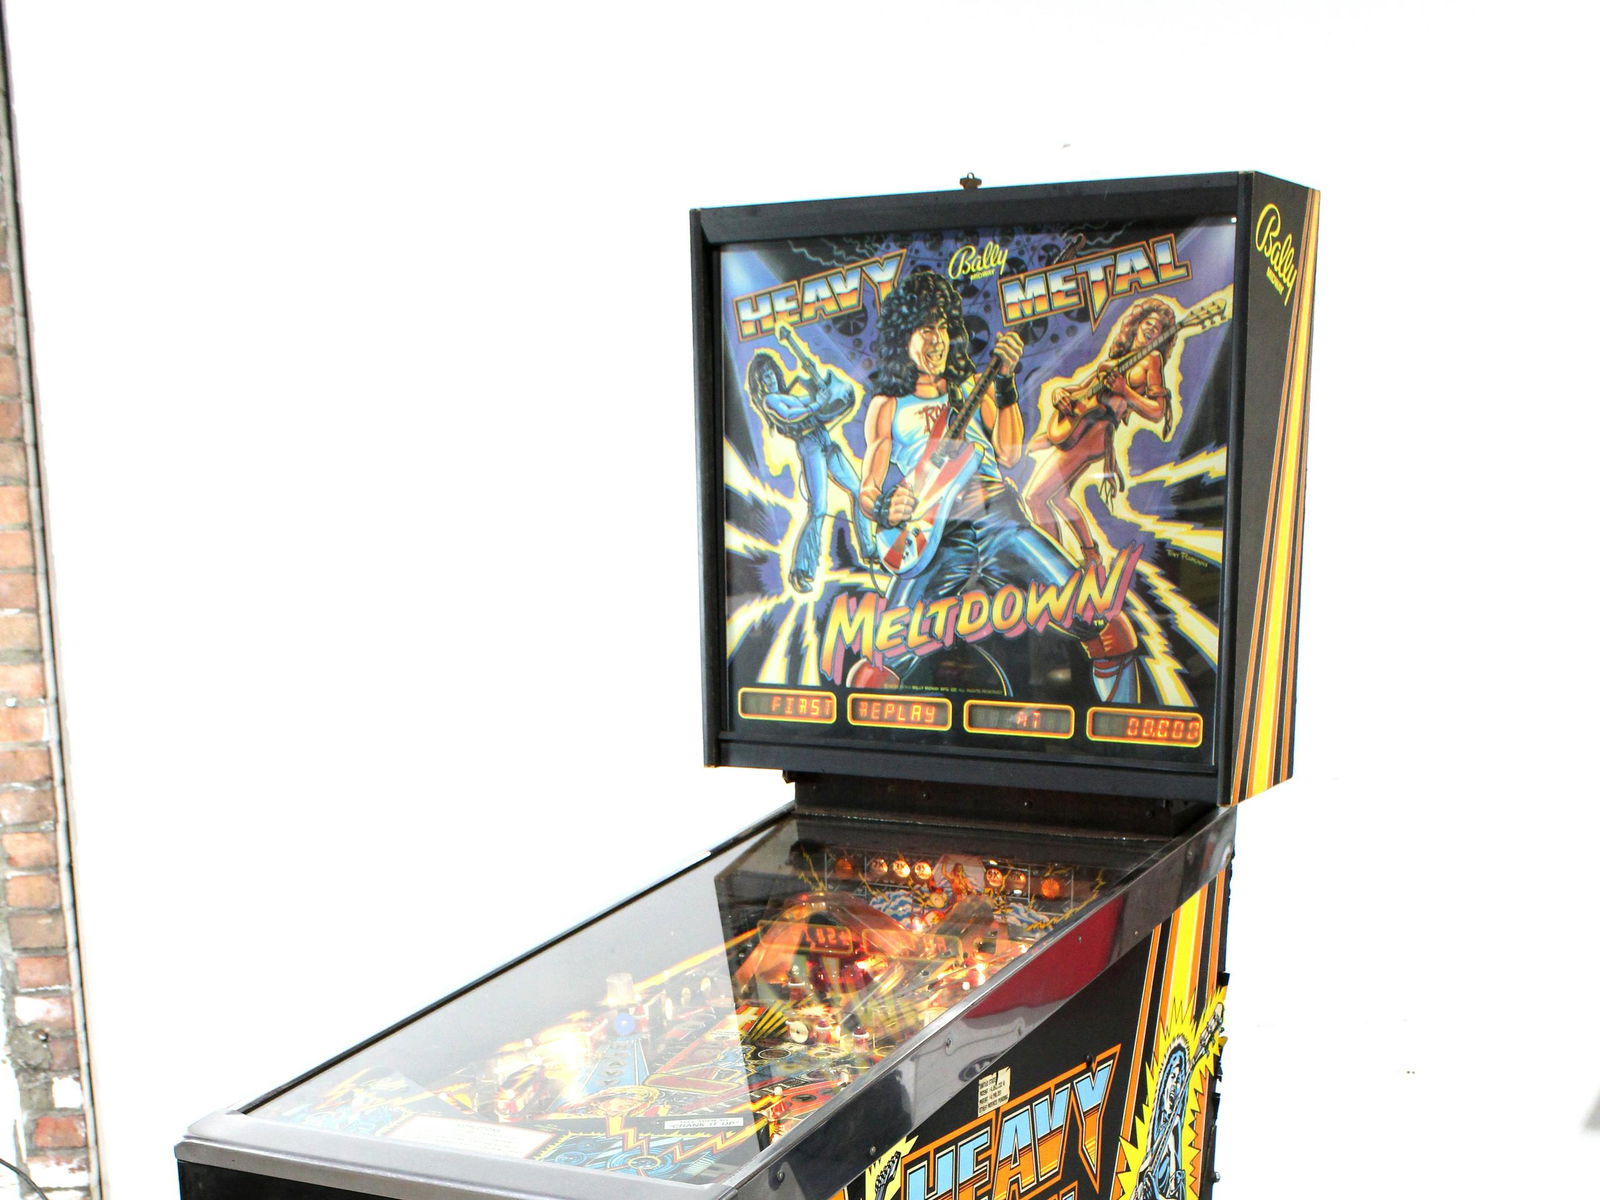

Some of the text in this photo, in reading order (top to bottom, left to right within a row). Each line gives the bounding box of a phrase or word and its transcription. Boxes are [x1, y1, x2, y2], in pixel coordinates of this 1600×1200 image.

[948, 240, 1008, 280] Bally
[1255, 203, 1297, 307] Bally
[736, 234, 1193, 341] HEAVY METAL
[821, 541, 1143, 684] MELTDOWN
[771, 695, 834, 717] FIRST
[859, 700, 936, 724] REPLAY
[1015, 709, 1042, 729] AT
